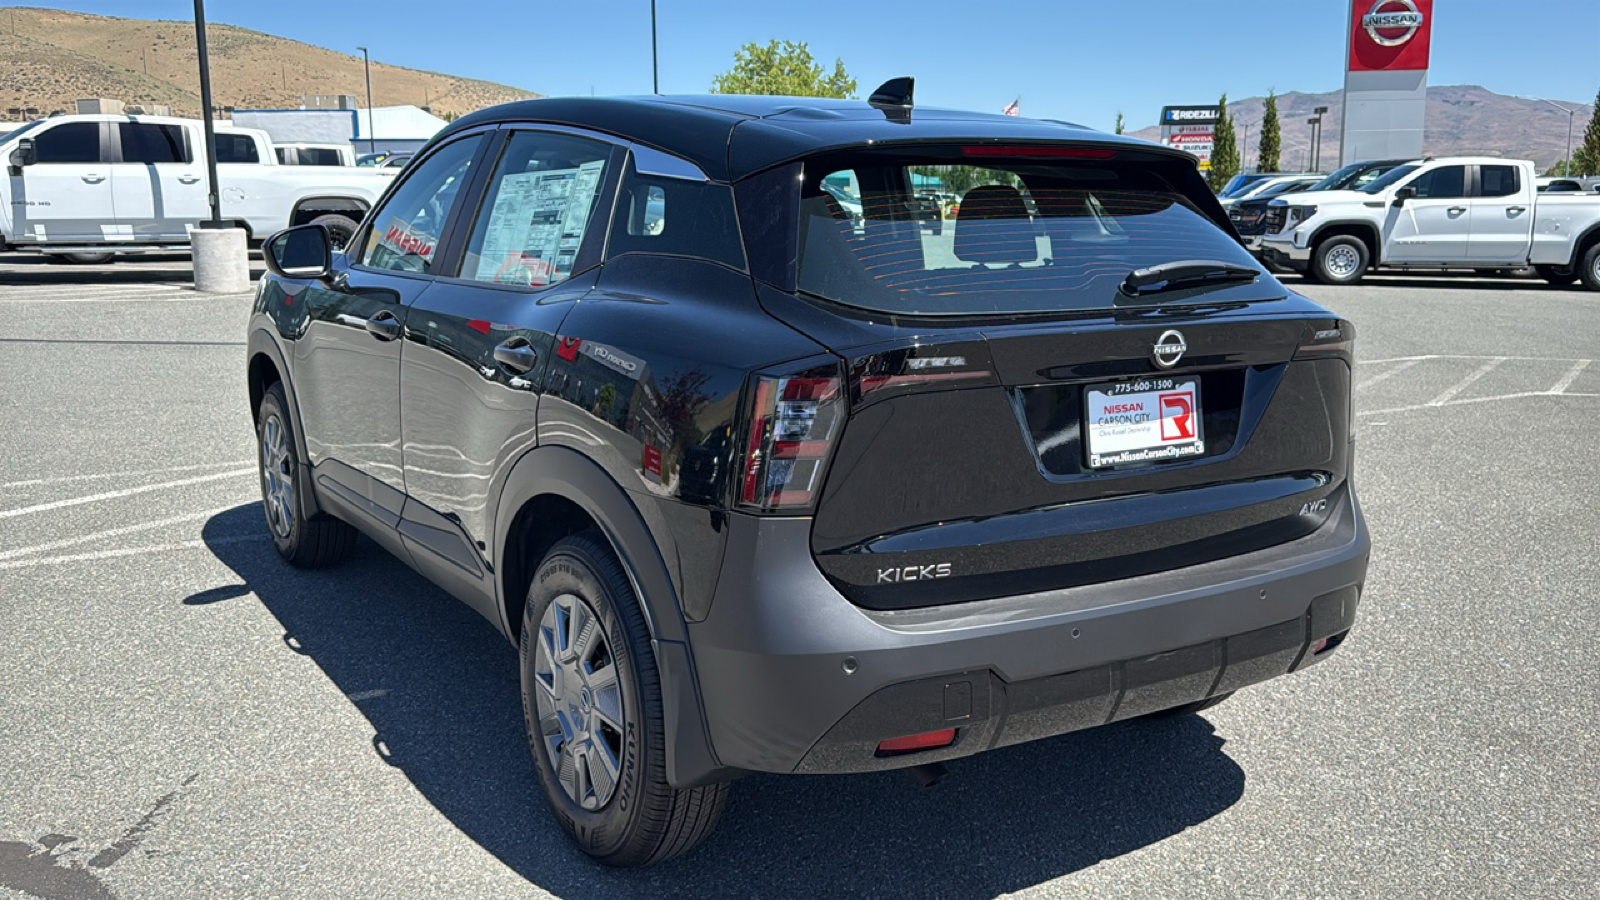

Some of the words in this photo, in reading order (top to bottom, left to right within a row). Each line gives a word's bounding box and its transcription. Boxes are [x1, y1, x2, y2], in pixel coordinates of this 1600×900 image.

[1369, 15, 1417, 25] NISSAN
[1114, 379, 1173, 393] 775-600-1500
[1103, 402, 1144, 415] NISSAN
[1098, 414, 1132, 426] CARSON
[1133, 413, 1150, 424] CITY
[1101, 446, 1194, 465] www.NissanCarsonCity.com
[877, 563, 951, 583] KICKS
[620, 721, 636, 812] KUMHO
